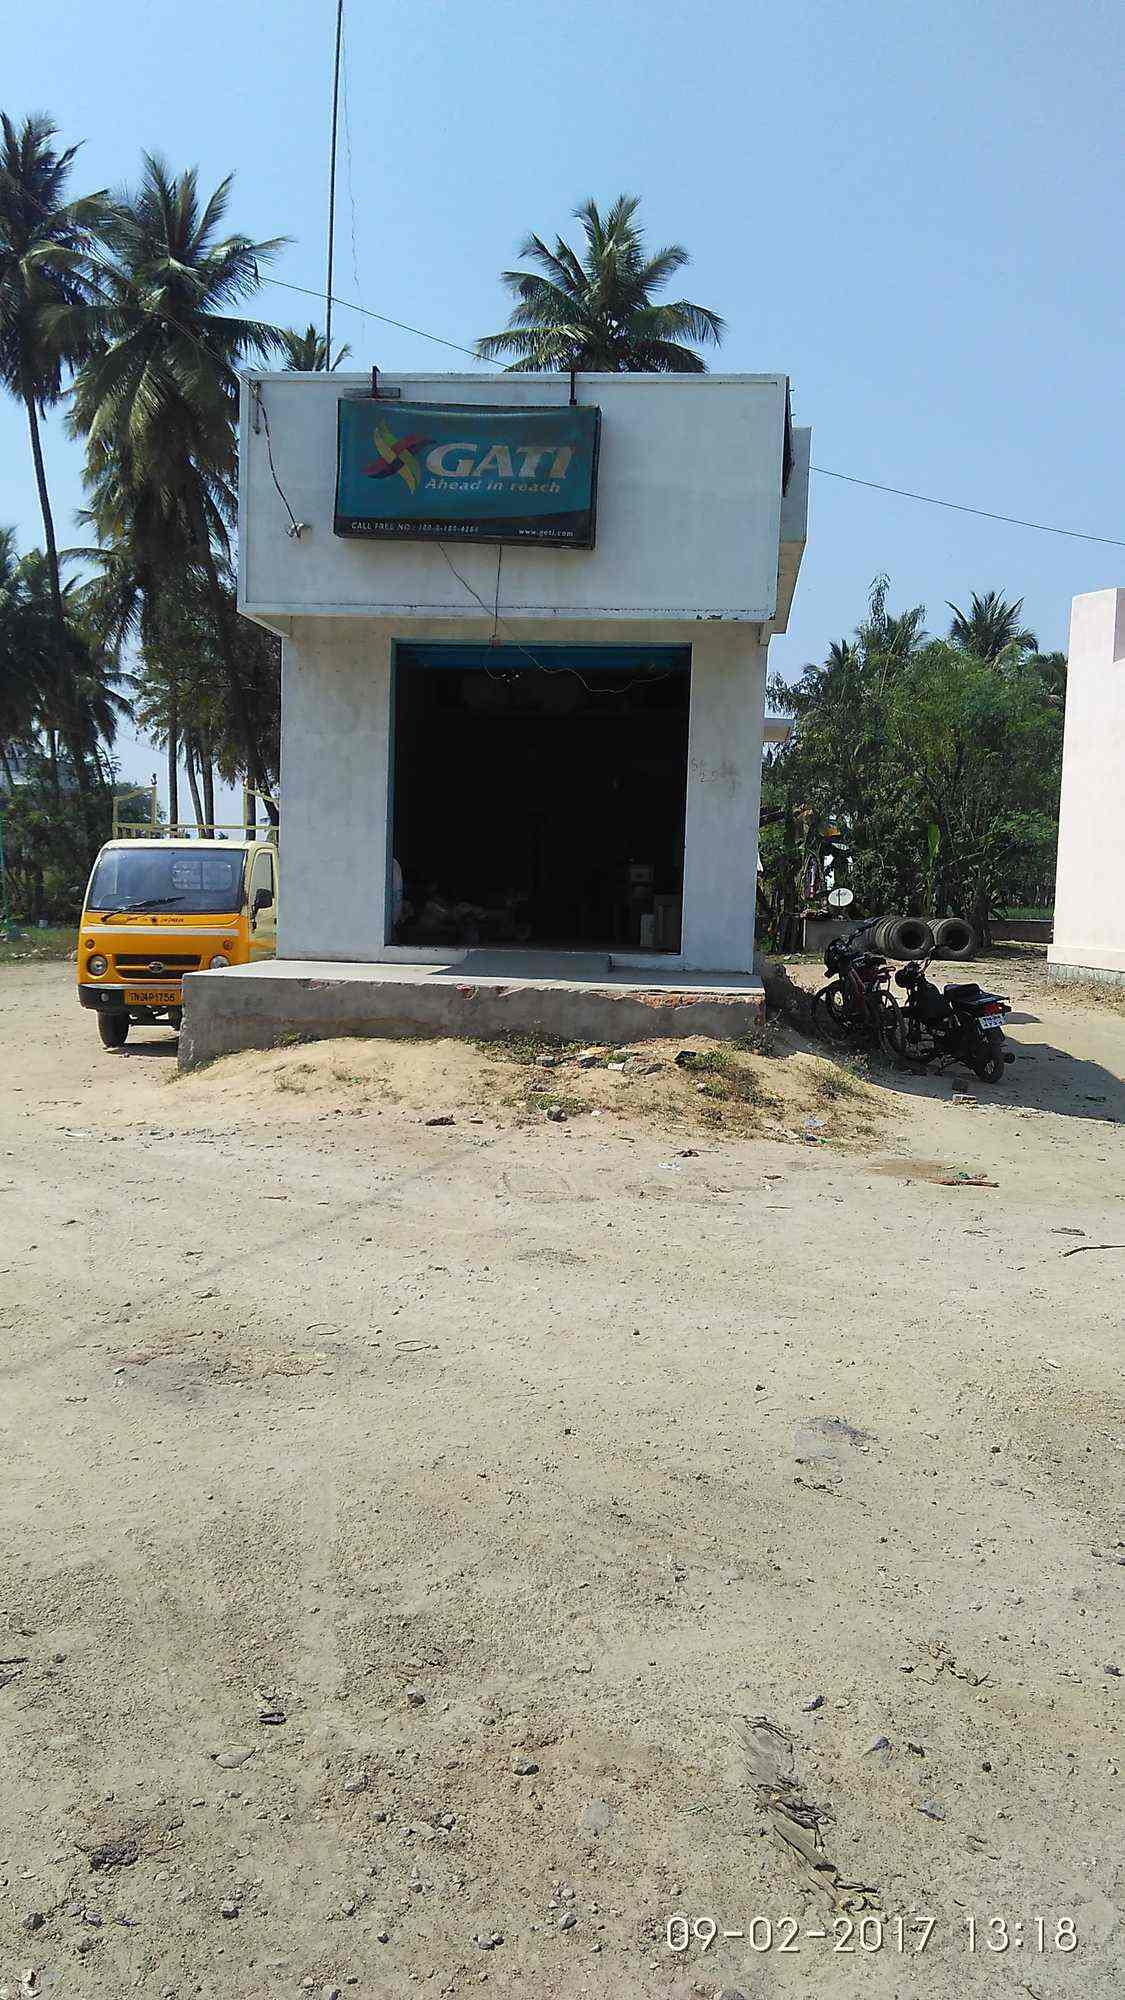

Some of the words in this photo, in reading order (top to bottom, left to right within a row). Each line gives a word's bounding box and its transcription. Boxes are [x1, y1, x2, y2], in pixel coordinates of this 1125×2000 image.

[427, 442, 575, 478] GATI
[425, 478, 482, 491] Ahead
[487, 480, 503, 491] in
[510, 482, 561, 494] reach
